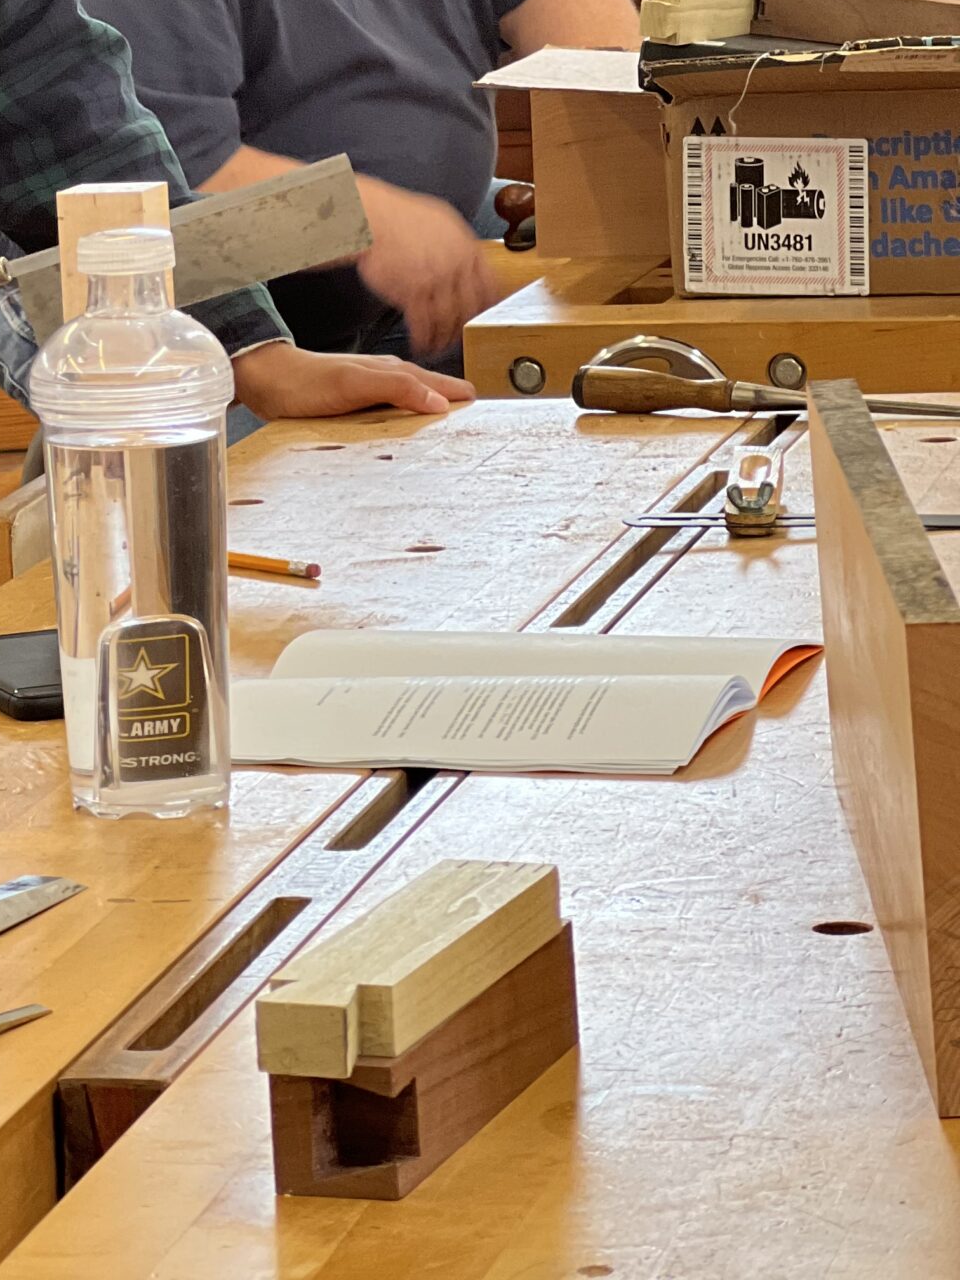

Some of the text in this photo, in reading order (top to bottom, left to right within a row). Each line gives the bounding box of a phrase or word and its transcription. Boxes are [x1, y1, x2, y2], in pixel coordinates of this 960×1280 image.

[881, 197, 933, 224] like
[744, 233, 812, 251] UN3481
[130, 718, 181, 737] ARMY
